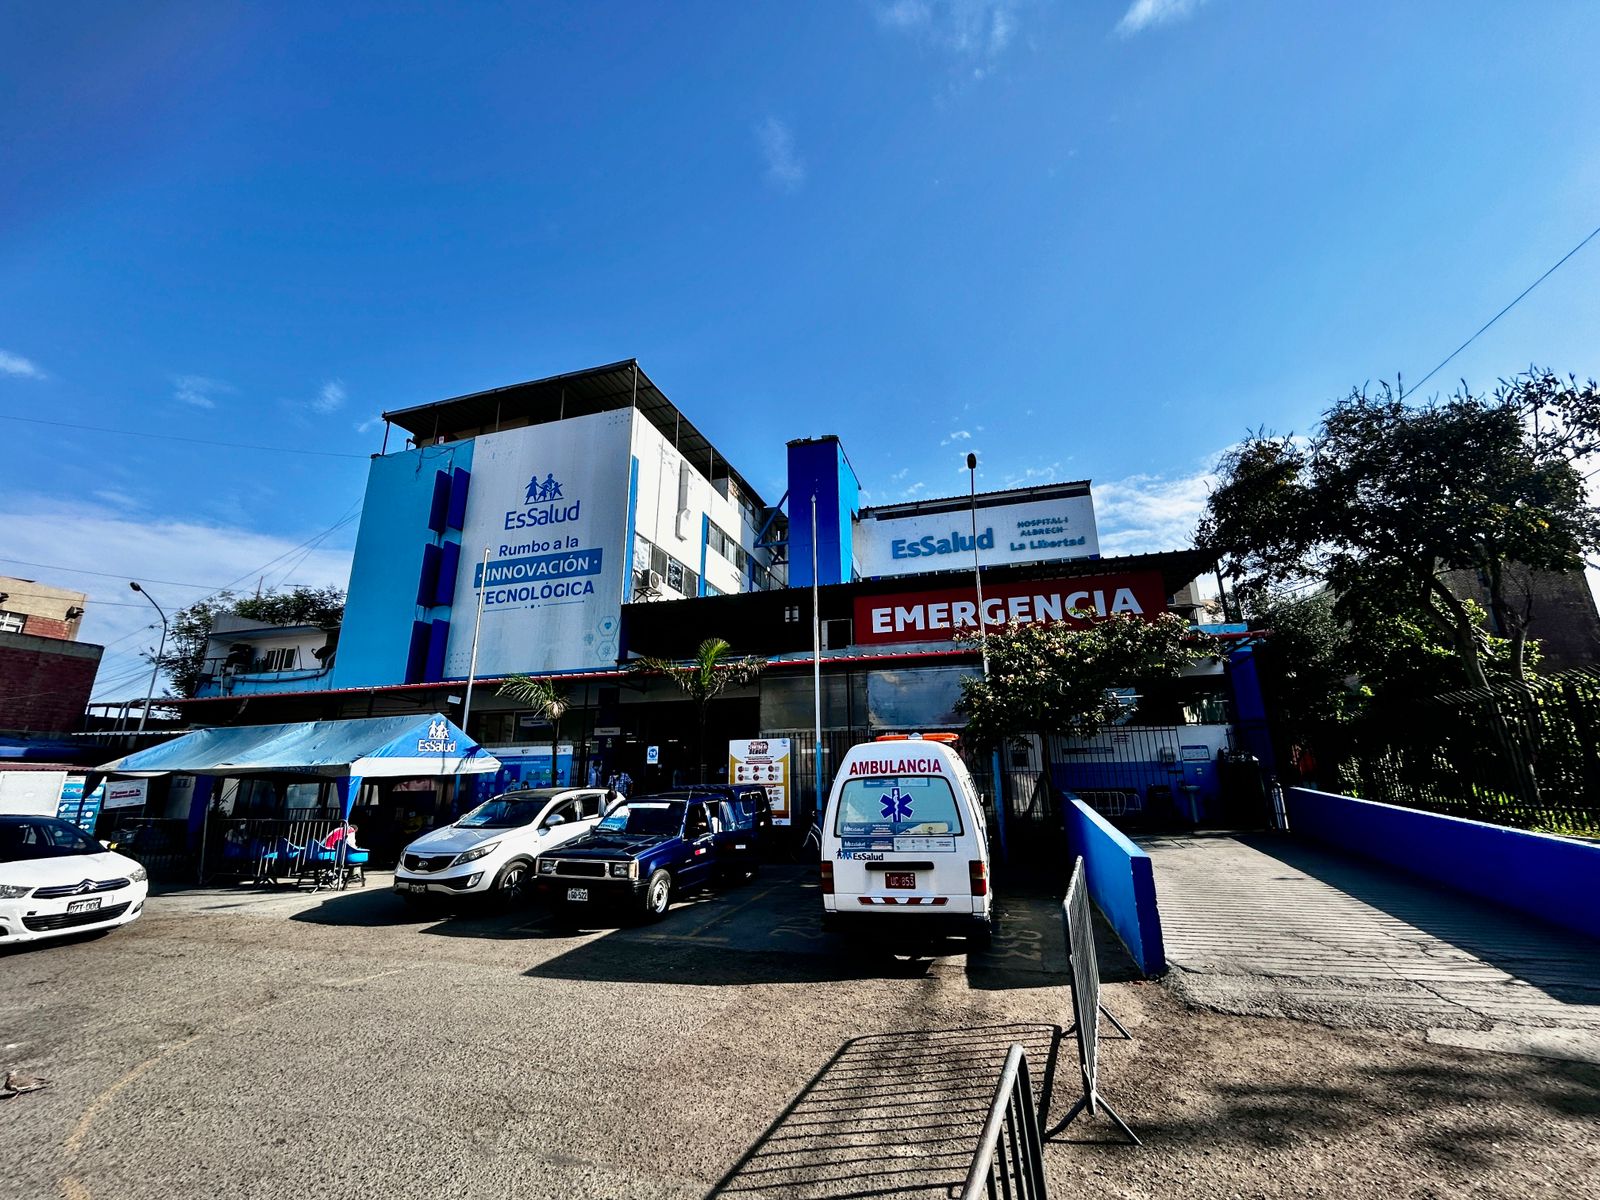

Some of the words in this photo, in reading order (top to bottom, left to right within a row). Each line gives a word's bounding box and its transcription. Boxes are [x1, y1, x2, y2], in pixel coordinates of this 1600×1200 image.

[504, 500, 580, 530] EsSalud
[498, 539, 550, 557] Rumbo
[553, 541, 563, 551] a
[566, 535, 579, 549] la
[891, 527, 995, 560] EsSalud
[1010, 542, 1026, 552] La
[1030, 535, 1086, 550] Libertad
[486, 555, 589, 582] INNOVACIÓN
[476, 580, 594, 605] TECNOLÓGICA
[871, 587, 1144, 634] EMERGENCIA
[418, 739, 457, 753] EsSalud
[849, 758, 942, 776] AMBULANCIA
[852, 851, 884, 861] EsSalud
